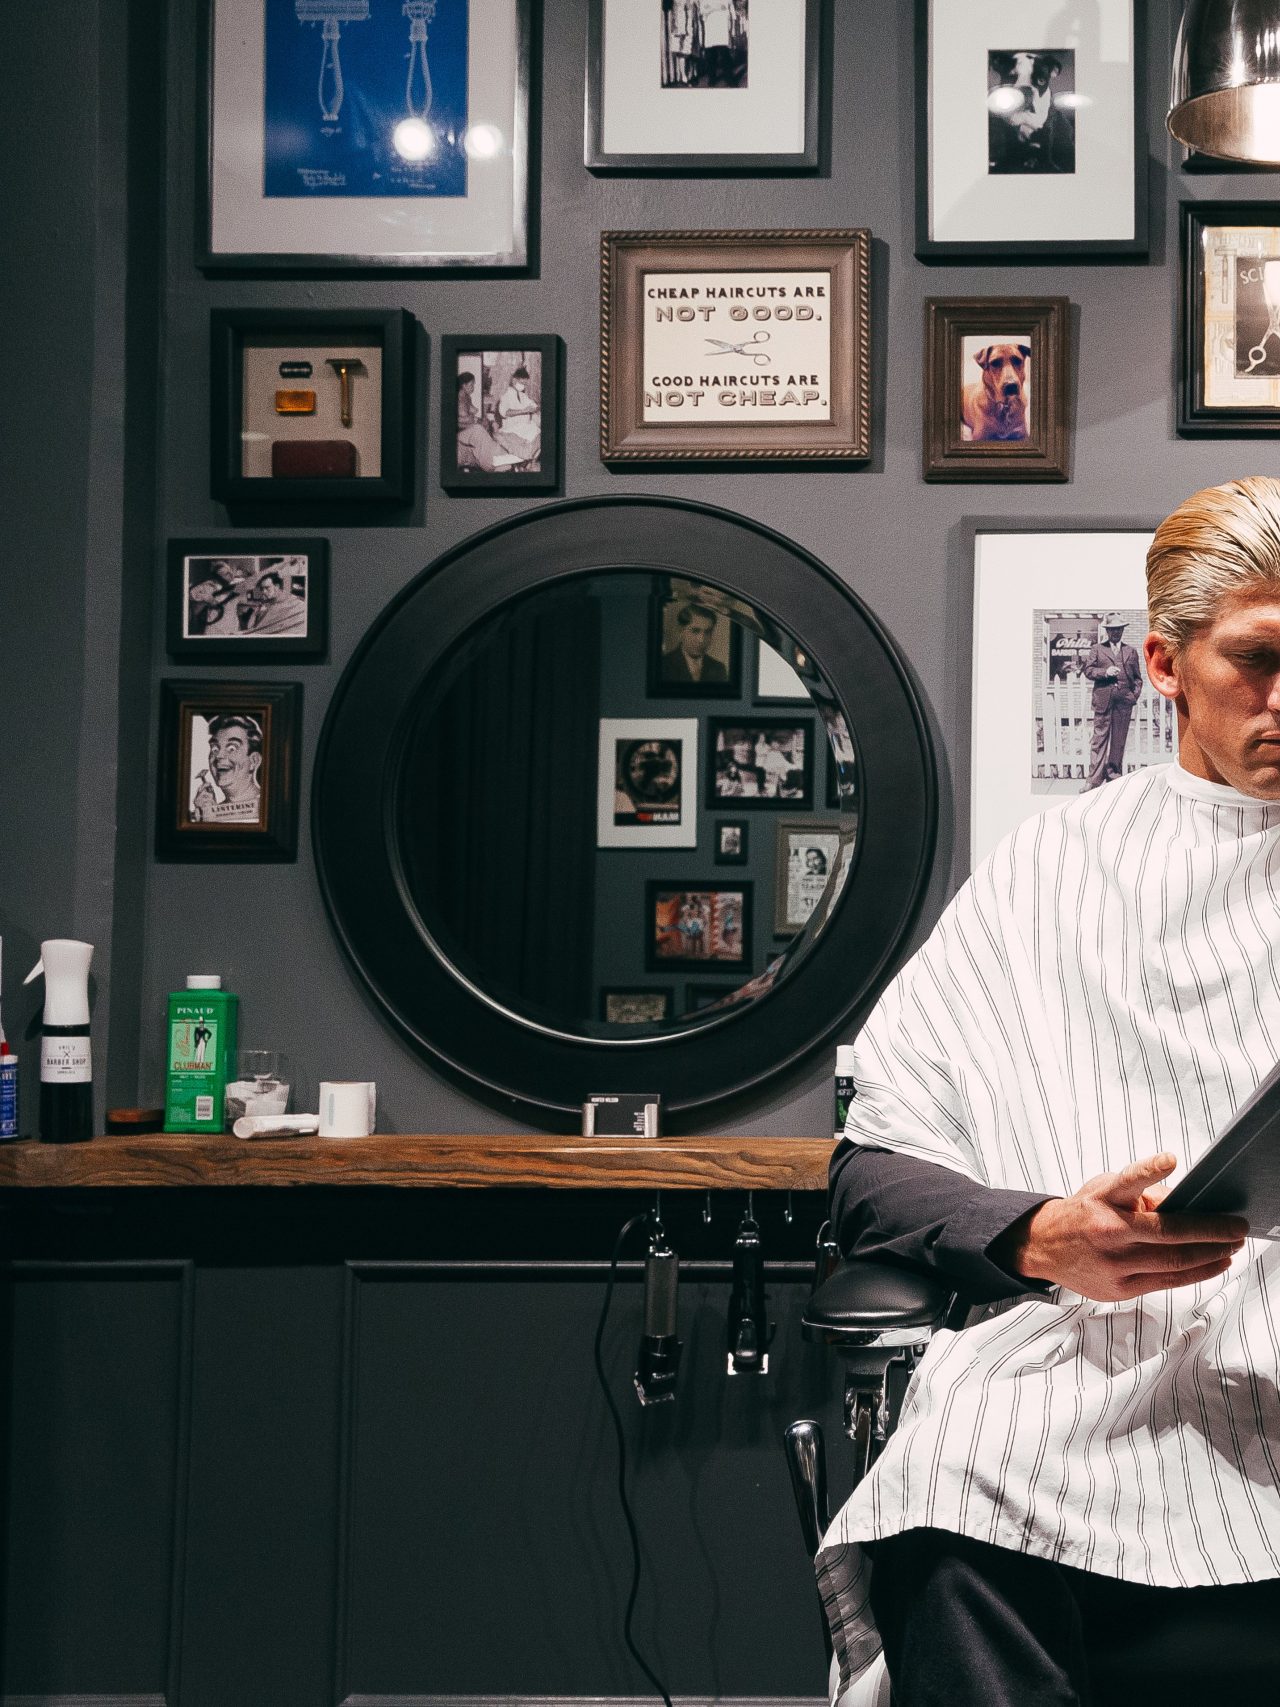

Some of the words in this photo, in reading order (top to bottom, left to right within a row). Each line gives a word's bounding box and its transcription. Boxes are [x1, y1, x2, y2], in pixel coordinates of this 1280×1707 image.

[647, 287, 700, 299] CHEAP
[706, 286, 787, 298] HAIRCUTS
[793, 286, 826, 298] ARE
[656, 306, 716, 322] NOT
[729, 305, 822, 322] GOOD.
[652, 375, 693, 387] GOOD
[700, 375, 780, 387] HAIRCUTS
[787, 375, 819, 386] ARE
[644, 390, 704, 407] NOT
[718, 390, 827, 407] CHEAP.
[46, 1058, 69, 1066] BARBER
[72, 1058, 87, 1066] SHOP
